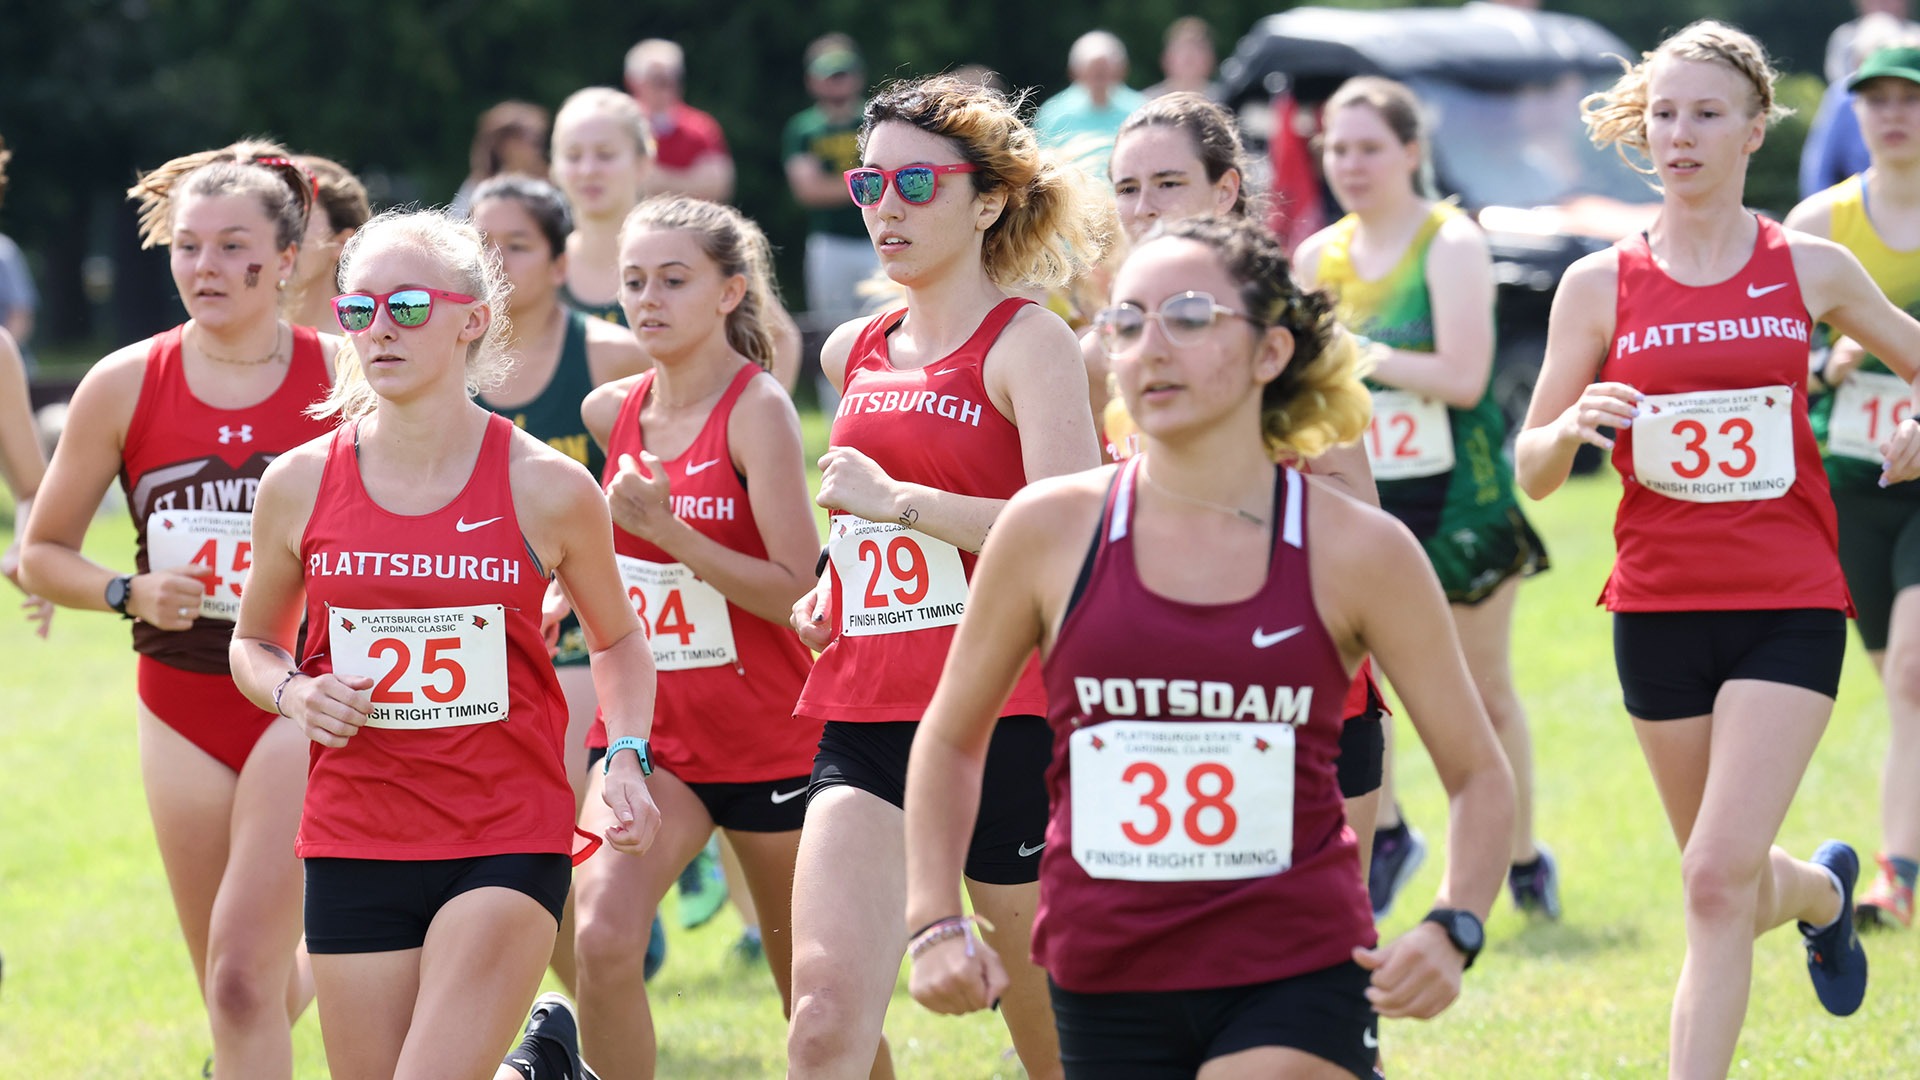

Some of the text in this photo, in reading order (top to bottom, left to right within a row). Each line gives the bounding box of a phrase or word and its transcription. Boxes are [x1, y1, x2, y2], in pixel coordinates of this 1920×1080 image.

[1616, 316, 1808, 359] PLATTSBURGH
[834, 391, 982, 427] ATTSBURGH
[1733, 395, 1758, 404] STATE
[1369, 412, 1421, 460] 12
[1671, 418, 1756, 479] 33
[1646, 478, 1785, 494] FINISH RIGHT TIMING
[854, 526, 883, 536] CARDINAL
[189, 538, 251, 598] 45
[310, 551, 519, 584] PLATTSBURGH
[859, 536, 929, 608] 29
[362, 613, 464, 624] PLATTSBURGH STATE
[371, 624, 456, 634] CARDINAL CLASSIC
[628, 585, 695, 645] 34
[849, 602, 964, 627] FINISH RIGHT TIMING
[681, 647, 726, 660] TIMING
[368, 637, 466, 704] 25
[395, 708, 441, 721] RIGHT
[446, 702, 499, 717] TIMING
[1074, 677, 1314, 725] POTSDAM
[1204, 731, 1241, 742] STATE
[1120, 761, 1238, 846] 38
[1085, 850, 1277, 869] FINISH RIGHT TIMING
